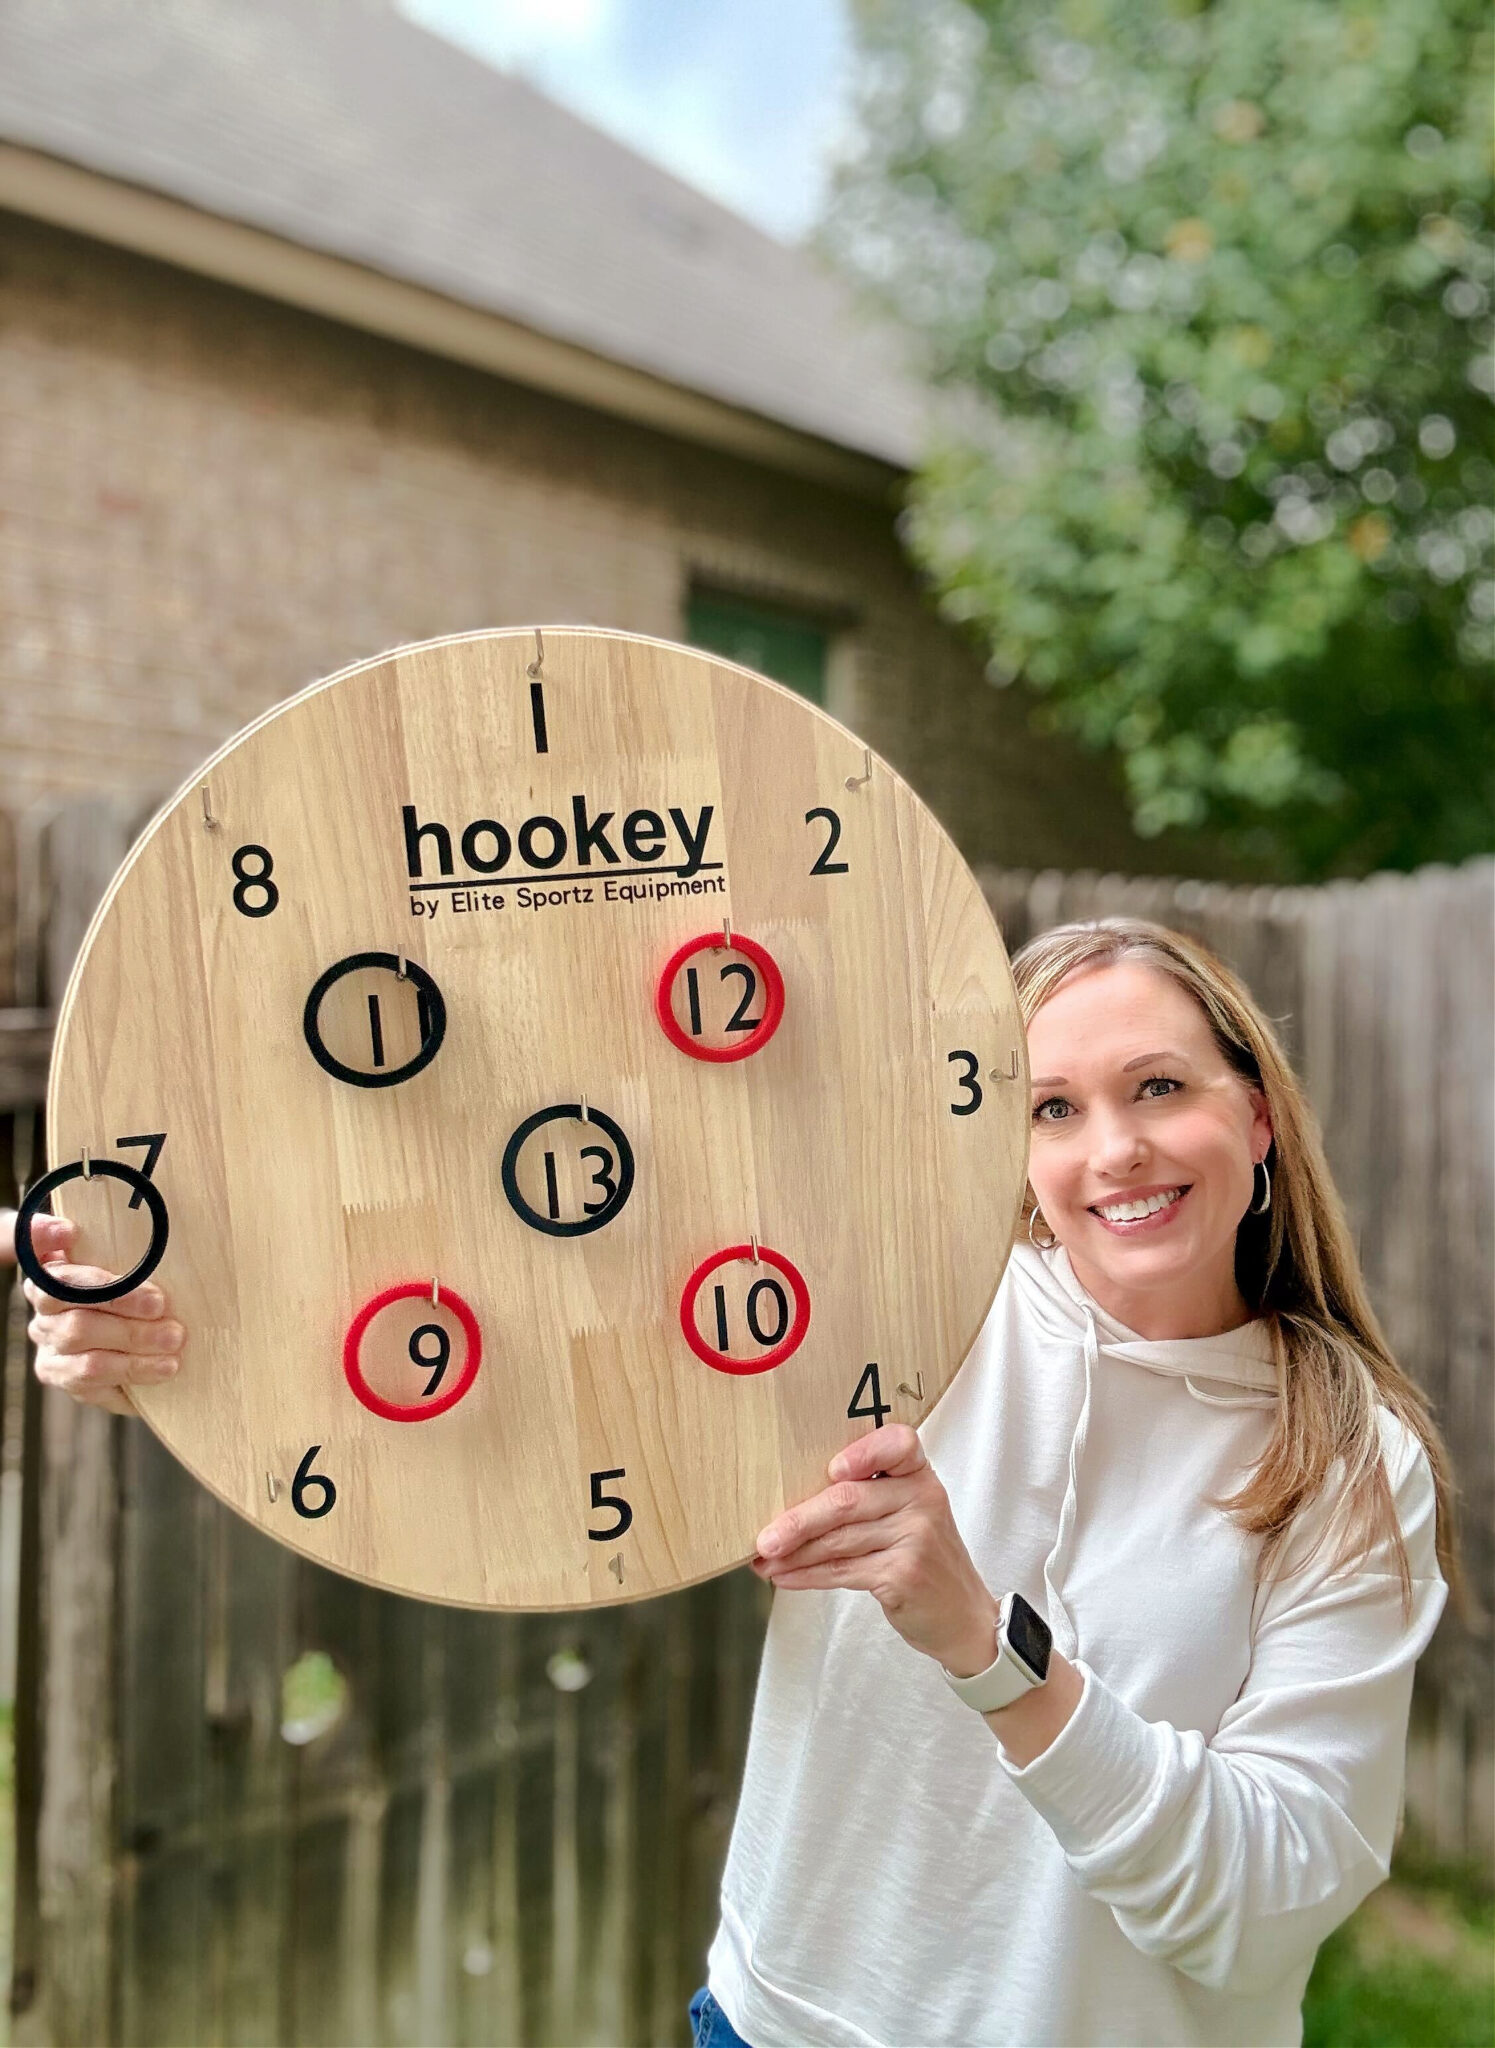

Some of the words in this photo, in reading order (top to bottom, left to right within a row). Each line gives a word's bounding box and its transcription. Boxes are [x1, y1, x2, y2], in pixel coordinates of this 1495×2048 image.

[531, 682, 549, 754] 1
[402, 795, 715, 879] hookey
[805, 807, 849, 876] 2
[231, 844, 279, 918] 8
[410, 895, 439, 919] by
[451, 890, 505, 913] Elite
[517, 884, 594, 911] Sportz
[604, 875, 726, 903] Equipment
[368, 985, 432, 1067] 11
[687, 963, 762, 1036] 12
[948, 1050, 983, 1116] 3
[116, 1132, 168, 1210] 7
[544, 1145, 618, 1220] 13
[714, 1278, 789, 1352] 10
[408, 1323, 451, 1397] 9
[847, 1362, 892, 1430] 4
[291, 1445, 337, 1519] 6
[588, 1468, 633, 1542] 5
